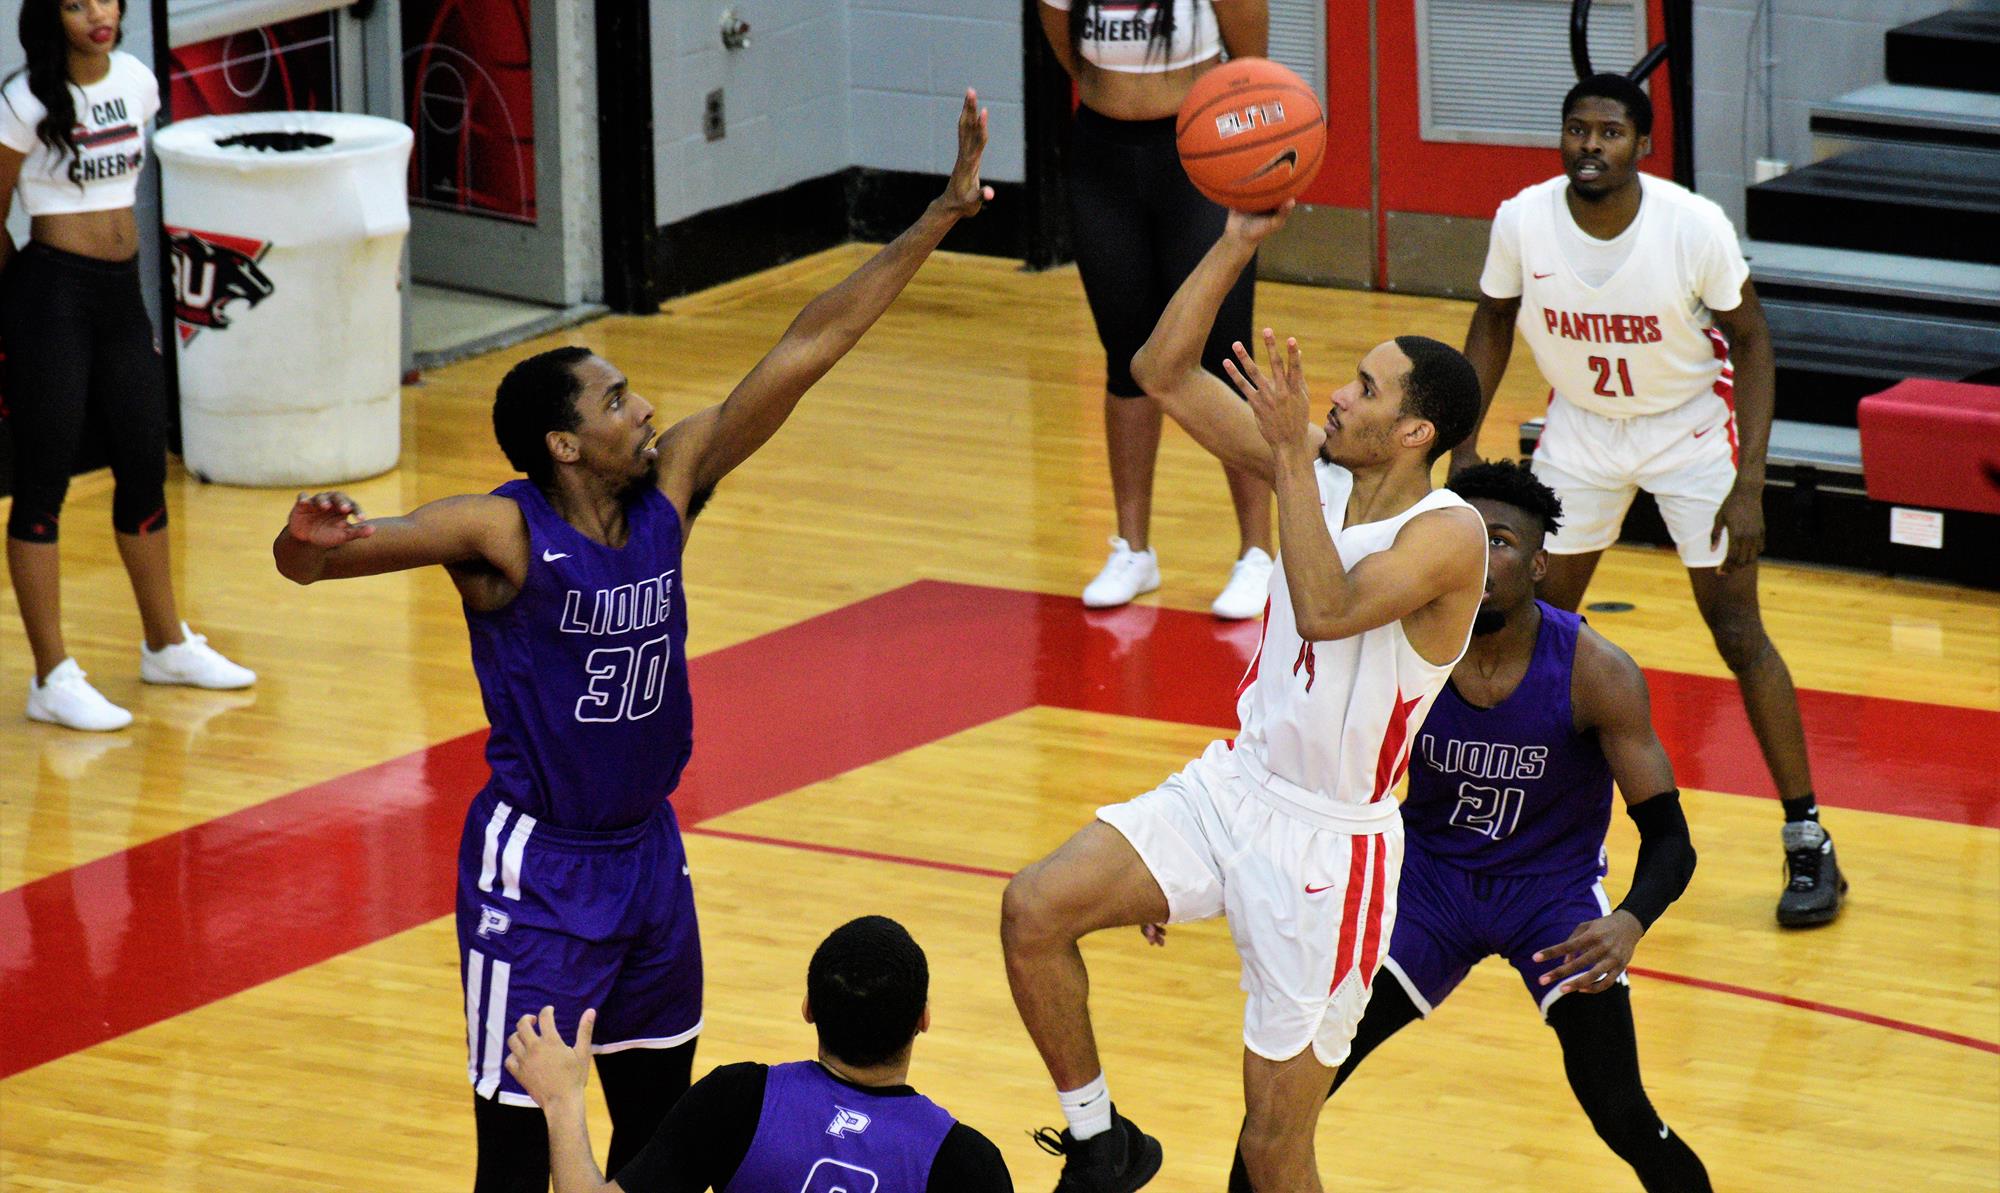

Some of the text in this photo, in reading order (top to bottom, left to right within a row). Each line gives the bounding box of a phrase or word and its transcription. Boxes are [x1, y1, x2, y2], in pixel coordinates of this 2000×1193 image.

[92, 97, 127, 126] CAU
[1543, 307, 1663, 344] PANTHERS
[1588, 355, 1635, 397] 21
[574, 633, 671, 723] 30
[1421, 733, 1549, 780] LIONS
[1448, 781, 1525, 841] 21
